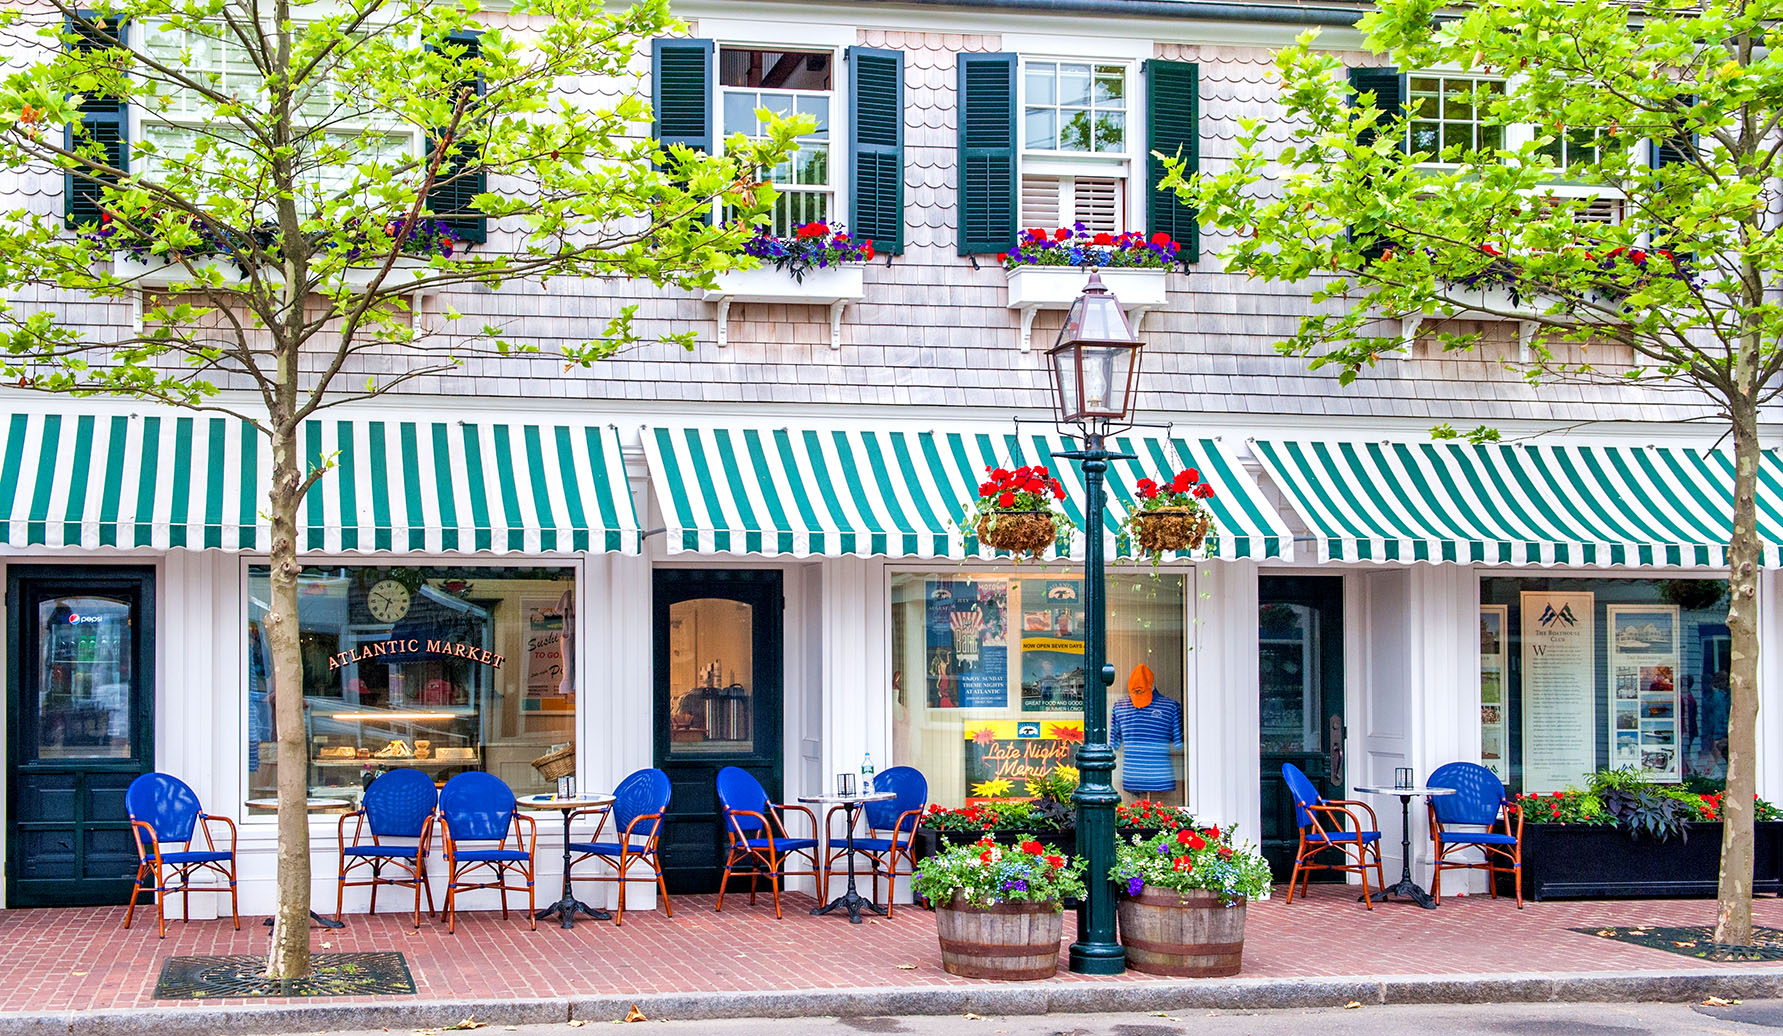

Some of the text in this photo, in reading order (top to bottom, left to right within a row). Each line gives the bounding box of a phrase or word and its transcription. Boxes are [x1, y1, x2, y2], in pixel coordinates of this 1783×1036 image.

[81, 616, 103, 624] pepsi
[528, 631, 559, 651] Sushi
[328, 639, 505, 671] ATLANTIC MARKET
[535, 651, 546, 659] TO
[986, 740, 1067, 764] Late Night
[995, 759, 1053, 777] Menu
